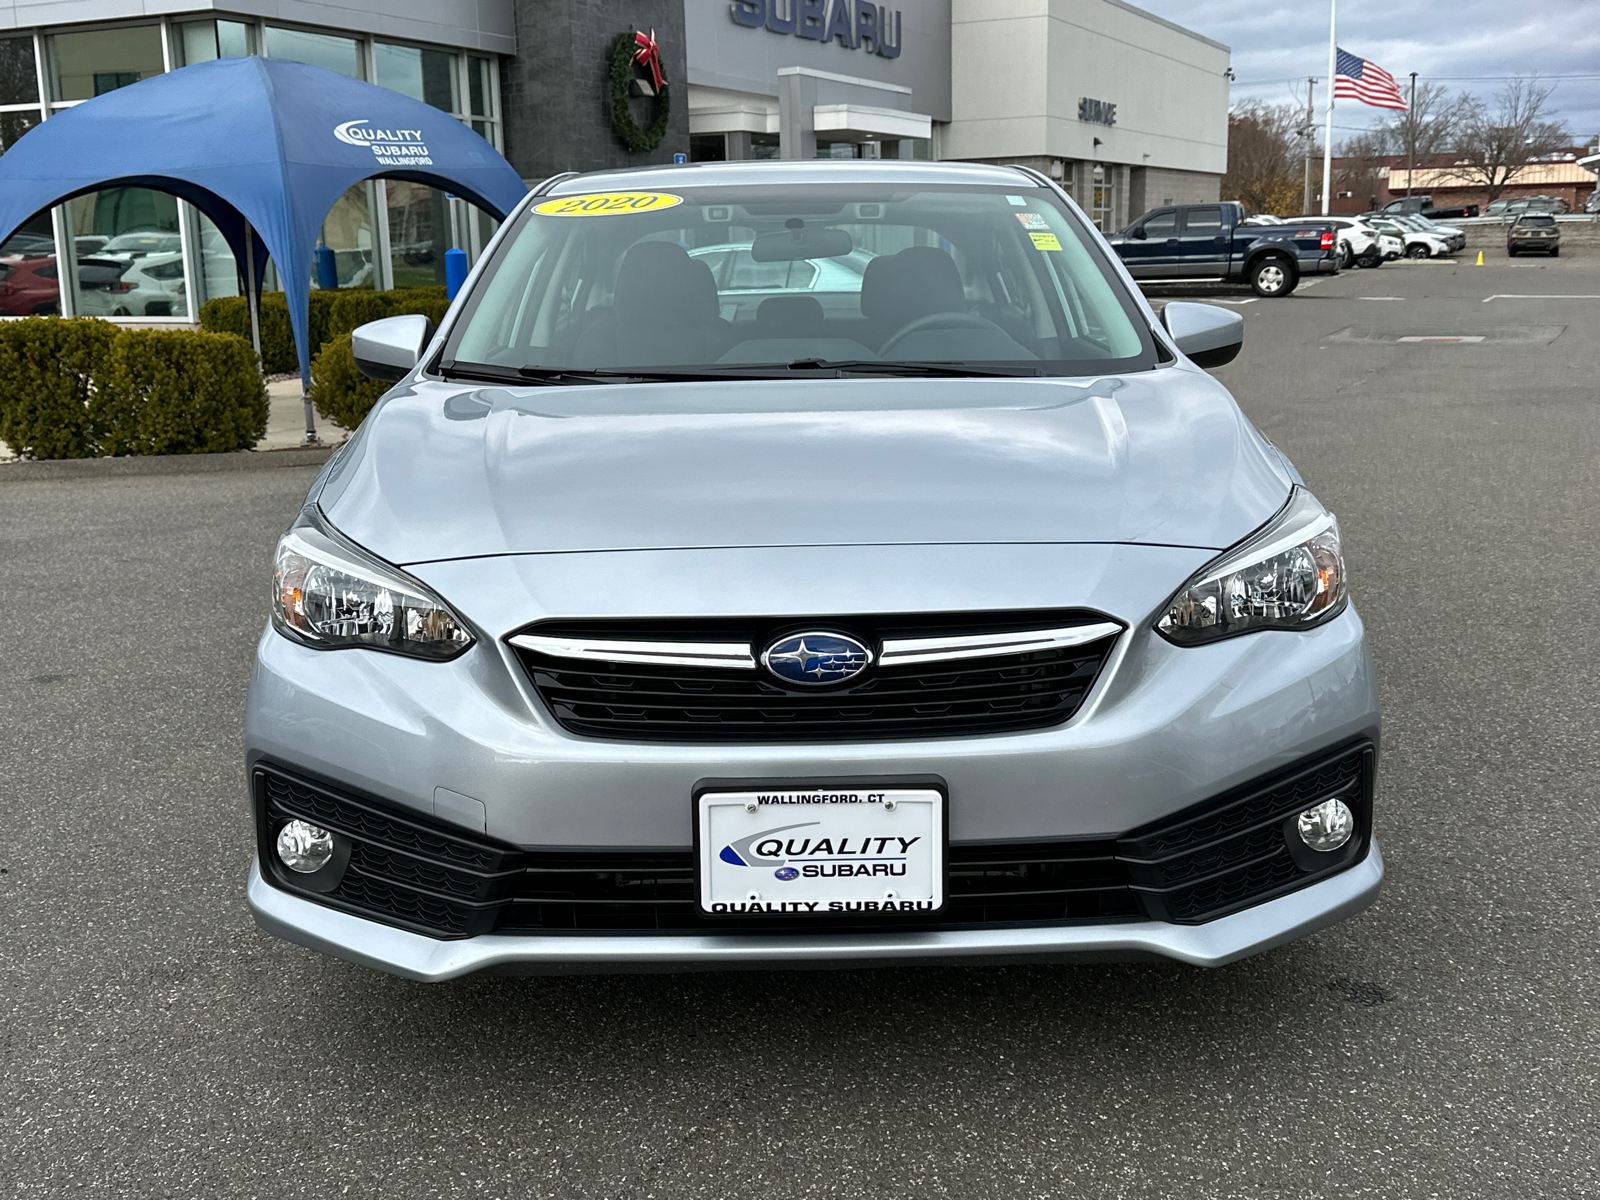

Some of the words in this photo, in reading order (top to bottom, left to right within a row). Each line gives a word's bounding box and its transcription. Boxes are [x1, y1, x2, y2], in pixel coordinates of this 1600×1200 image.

[348, 128, 421, 141] QUALITY
[371, 145, 429, 156] SUBARU
[375, 156, 433, 166] WALLINGFORD
[555, 195, 658, 213] 2020
[757, 794, 862, 805] WALLINGFORD,
[867, 793, 885, 803] CT
[755, 836, 921, 858] QUALITY
[802, 863, 907, 878] SUBARU
[711, 901, 819, 914] QUALITY
[828, 900, 934, 912] SUBARU
